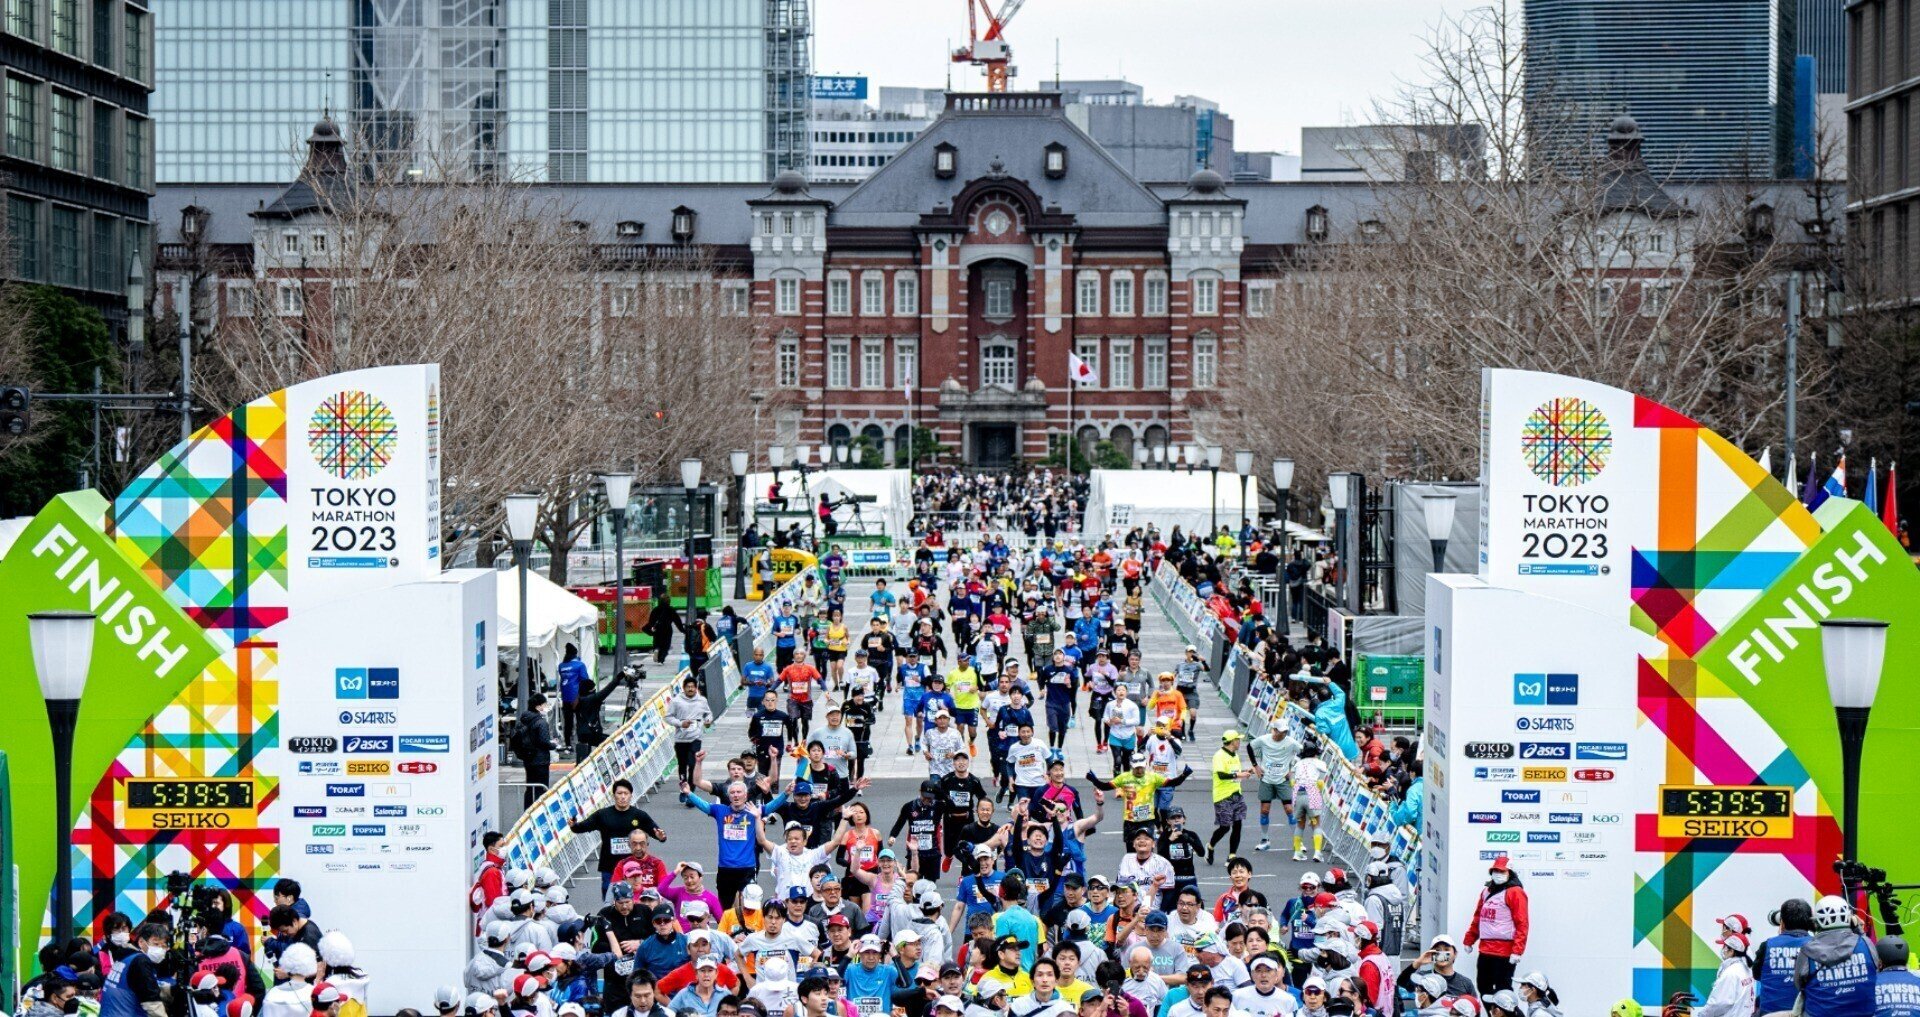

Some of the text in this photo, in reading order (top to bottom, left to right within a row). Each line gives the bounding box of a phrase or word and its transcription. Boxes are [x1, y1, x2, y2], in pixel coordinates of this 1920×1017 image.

[311, 488, 397, 506] TOKYO
[1523, 495, 1609, 513] TOKYO
[312, 511, 395, 522] MARATHON
[1524, 518, 1607, 529] MARATHON
[311, 526, 397, 551] 2023
[1522, 533, 1608, 559] 2023
[31, 522, 189, 679] FINISH
[1726, 529, 1888, 686] FINISH
[294, 738, 333, 747] TOKIO
[361, 740, 388, 750] asics
[1471, 744, 1509, 752] TOKIO
[1537, 746, 1565, 756] asics
[348, 763, 389, 773] SEIKO
[402, 764, 433, 772] 第一生命
[1524, 770, 1566, 779] SEIKO
[153, 783, 251, 807] 5:39:57
[1687, 791, 1787, 815] 5:39:57
[375, 808, 404, 817] Salonpas
[152, 813, 230, 828] SEIKO
[1550, 815, 1579, 823] Salonpas
[314, 826, 345, 834] バスクリン
[1684, 820, 1768, 837] SEIKO
[1769, 957, 1796, 969] CAM
[1816, 963, 1868, 982] CAMERA
